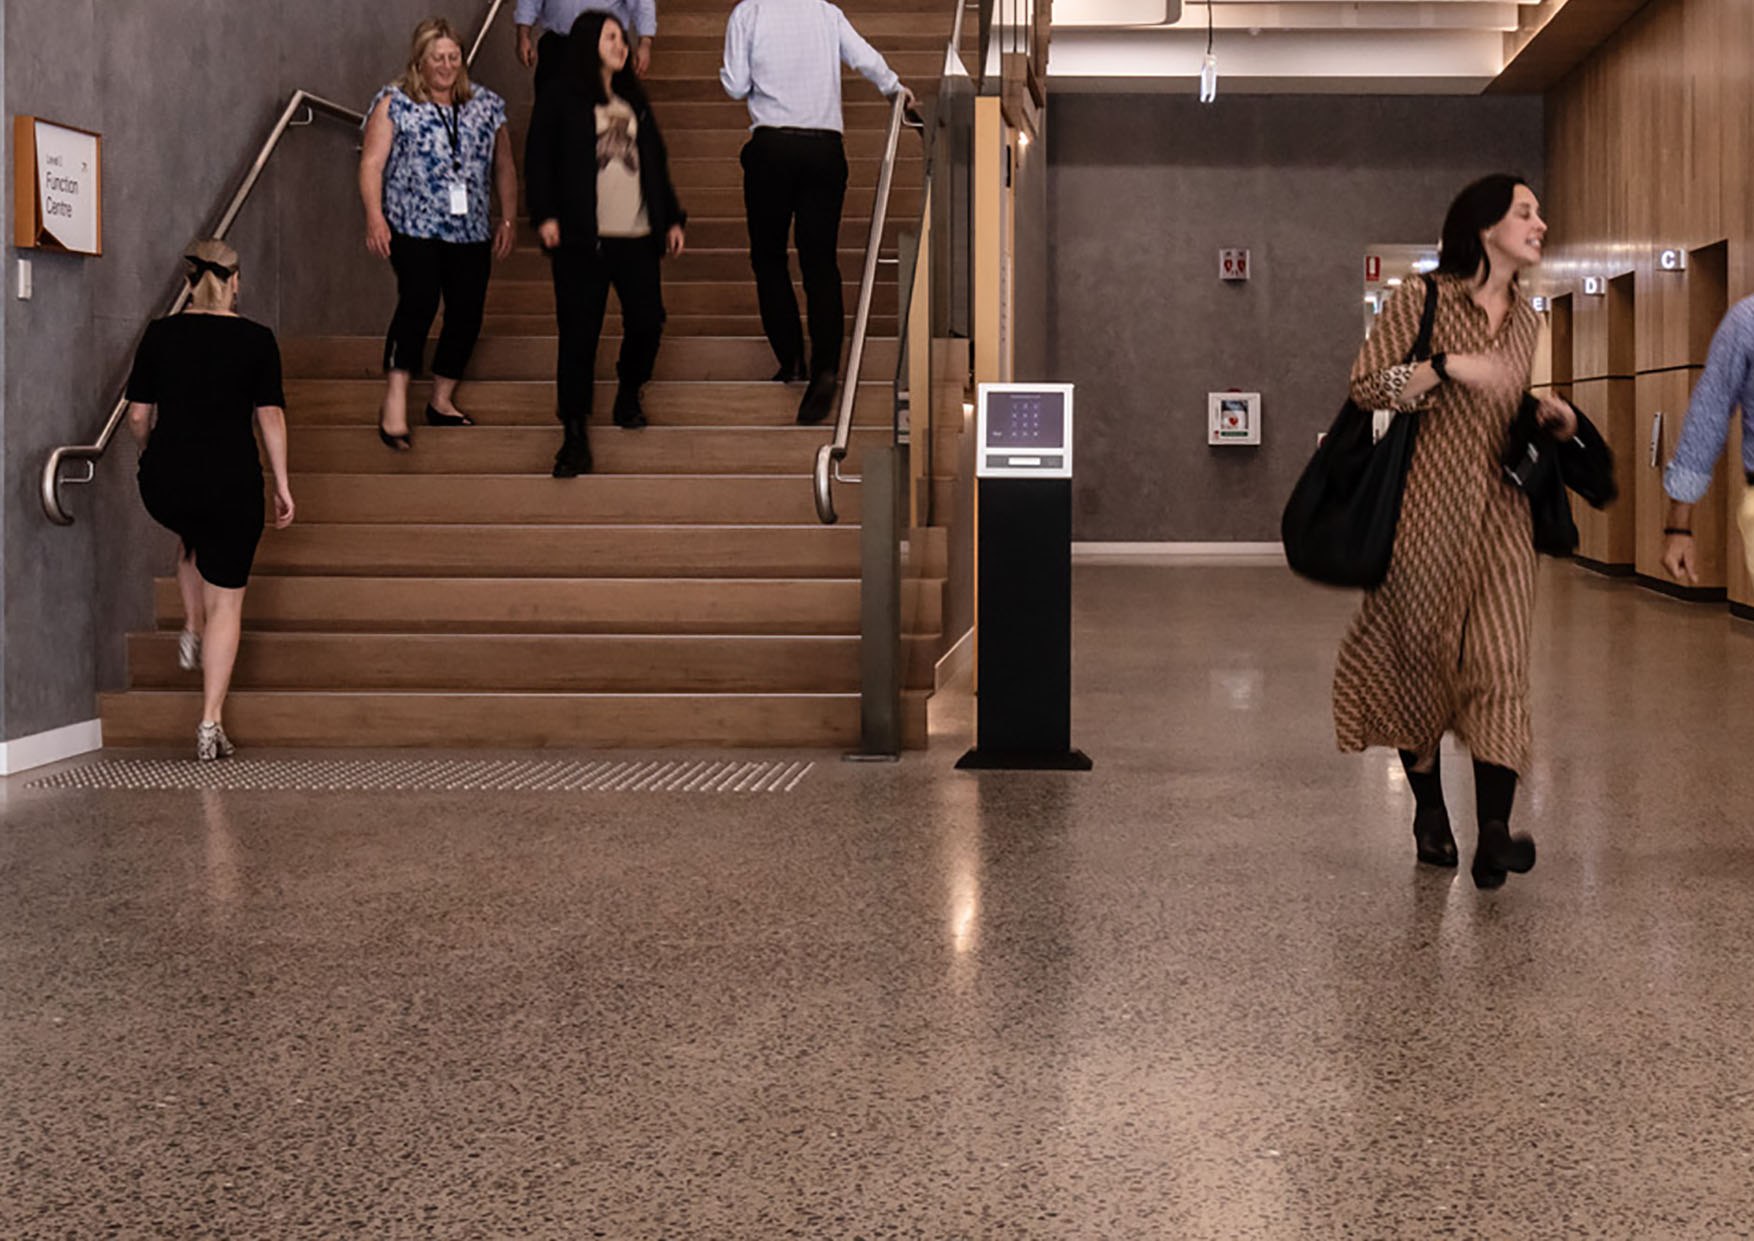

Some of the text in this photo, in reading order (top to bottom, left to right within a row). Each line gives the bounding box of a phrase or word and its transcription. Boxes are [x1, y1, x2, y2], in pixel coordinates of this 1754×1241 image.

[46, 170, 79, 195] Function
[46, 195, 73, 219] Centre
[1661, 250, 1676, 270] C
[1584, 276, 1598, 295] D
[1532, 296, 1544, 312] E
